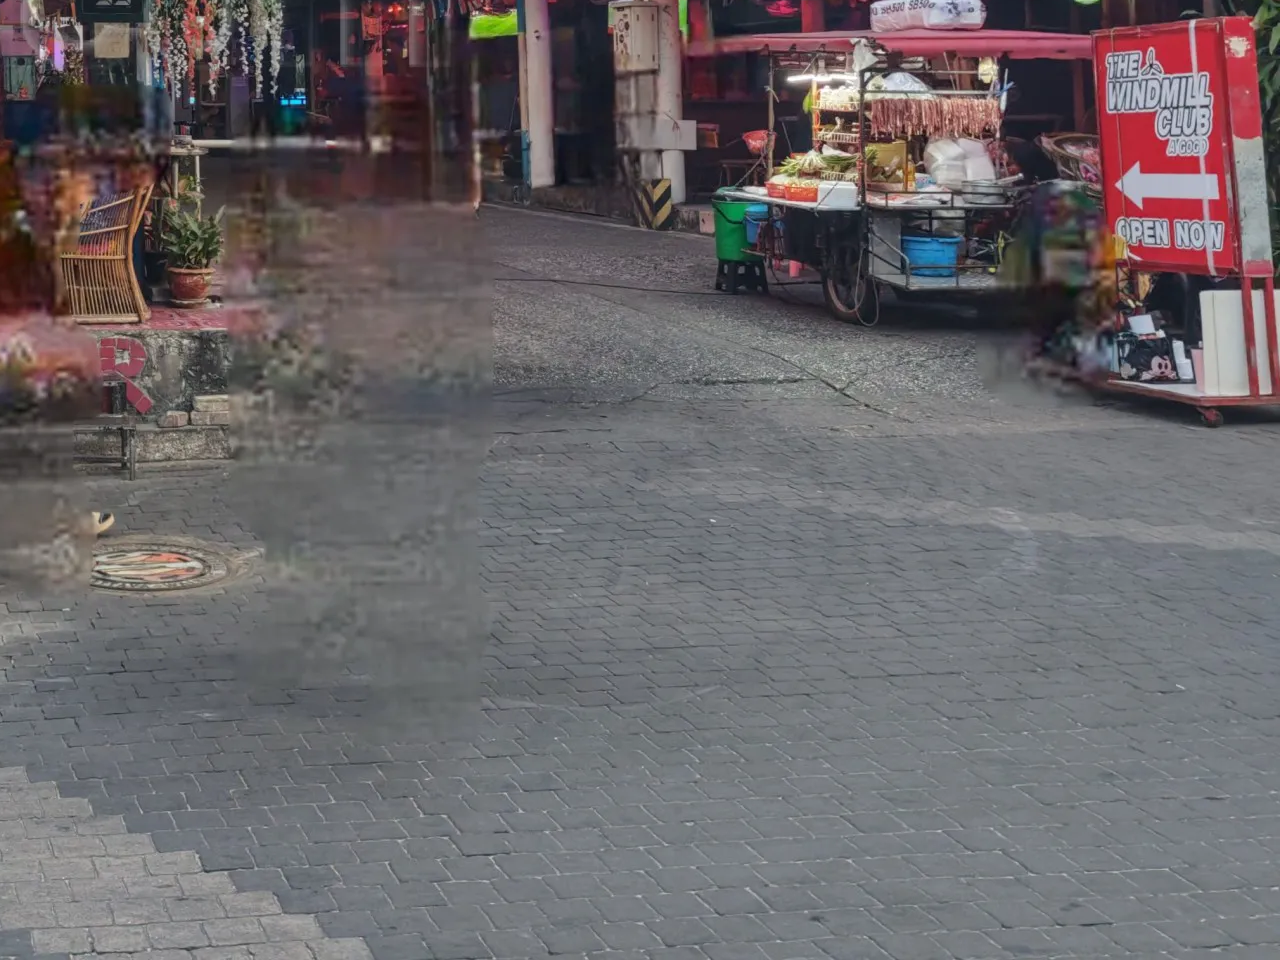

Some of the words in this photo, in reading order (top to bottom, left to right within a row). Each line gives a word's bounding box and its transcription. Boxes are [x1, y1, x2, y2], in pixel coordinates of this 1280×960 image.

[1107, 53, 1140, 80] THE
[1107, 74, 1212, 111] WINDMILL
[1156, 106, 1211, 138] CLUB
[1117, 218, 1169, 246] OPEN
[1174, 219, 1224, 250] NOW
